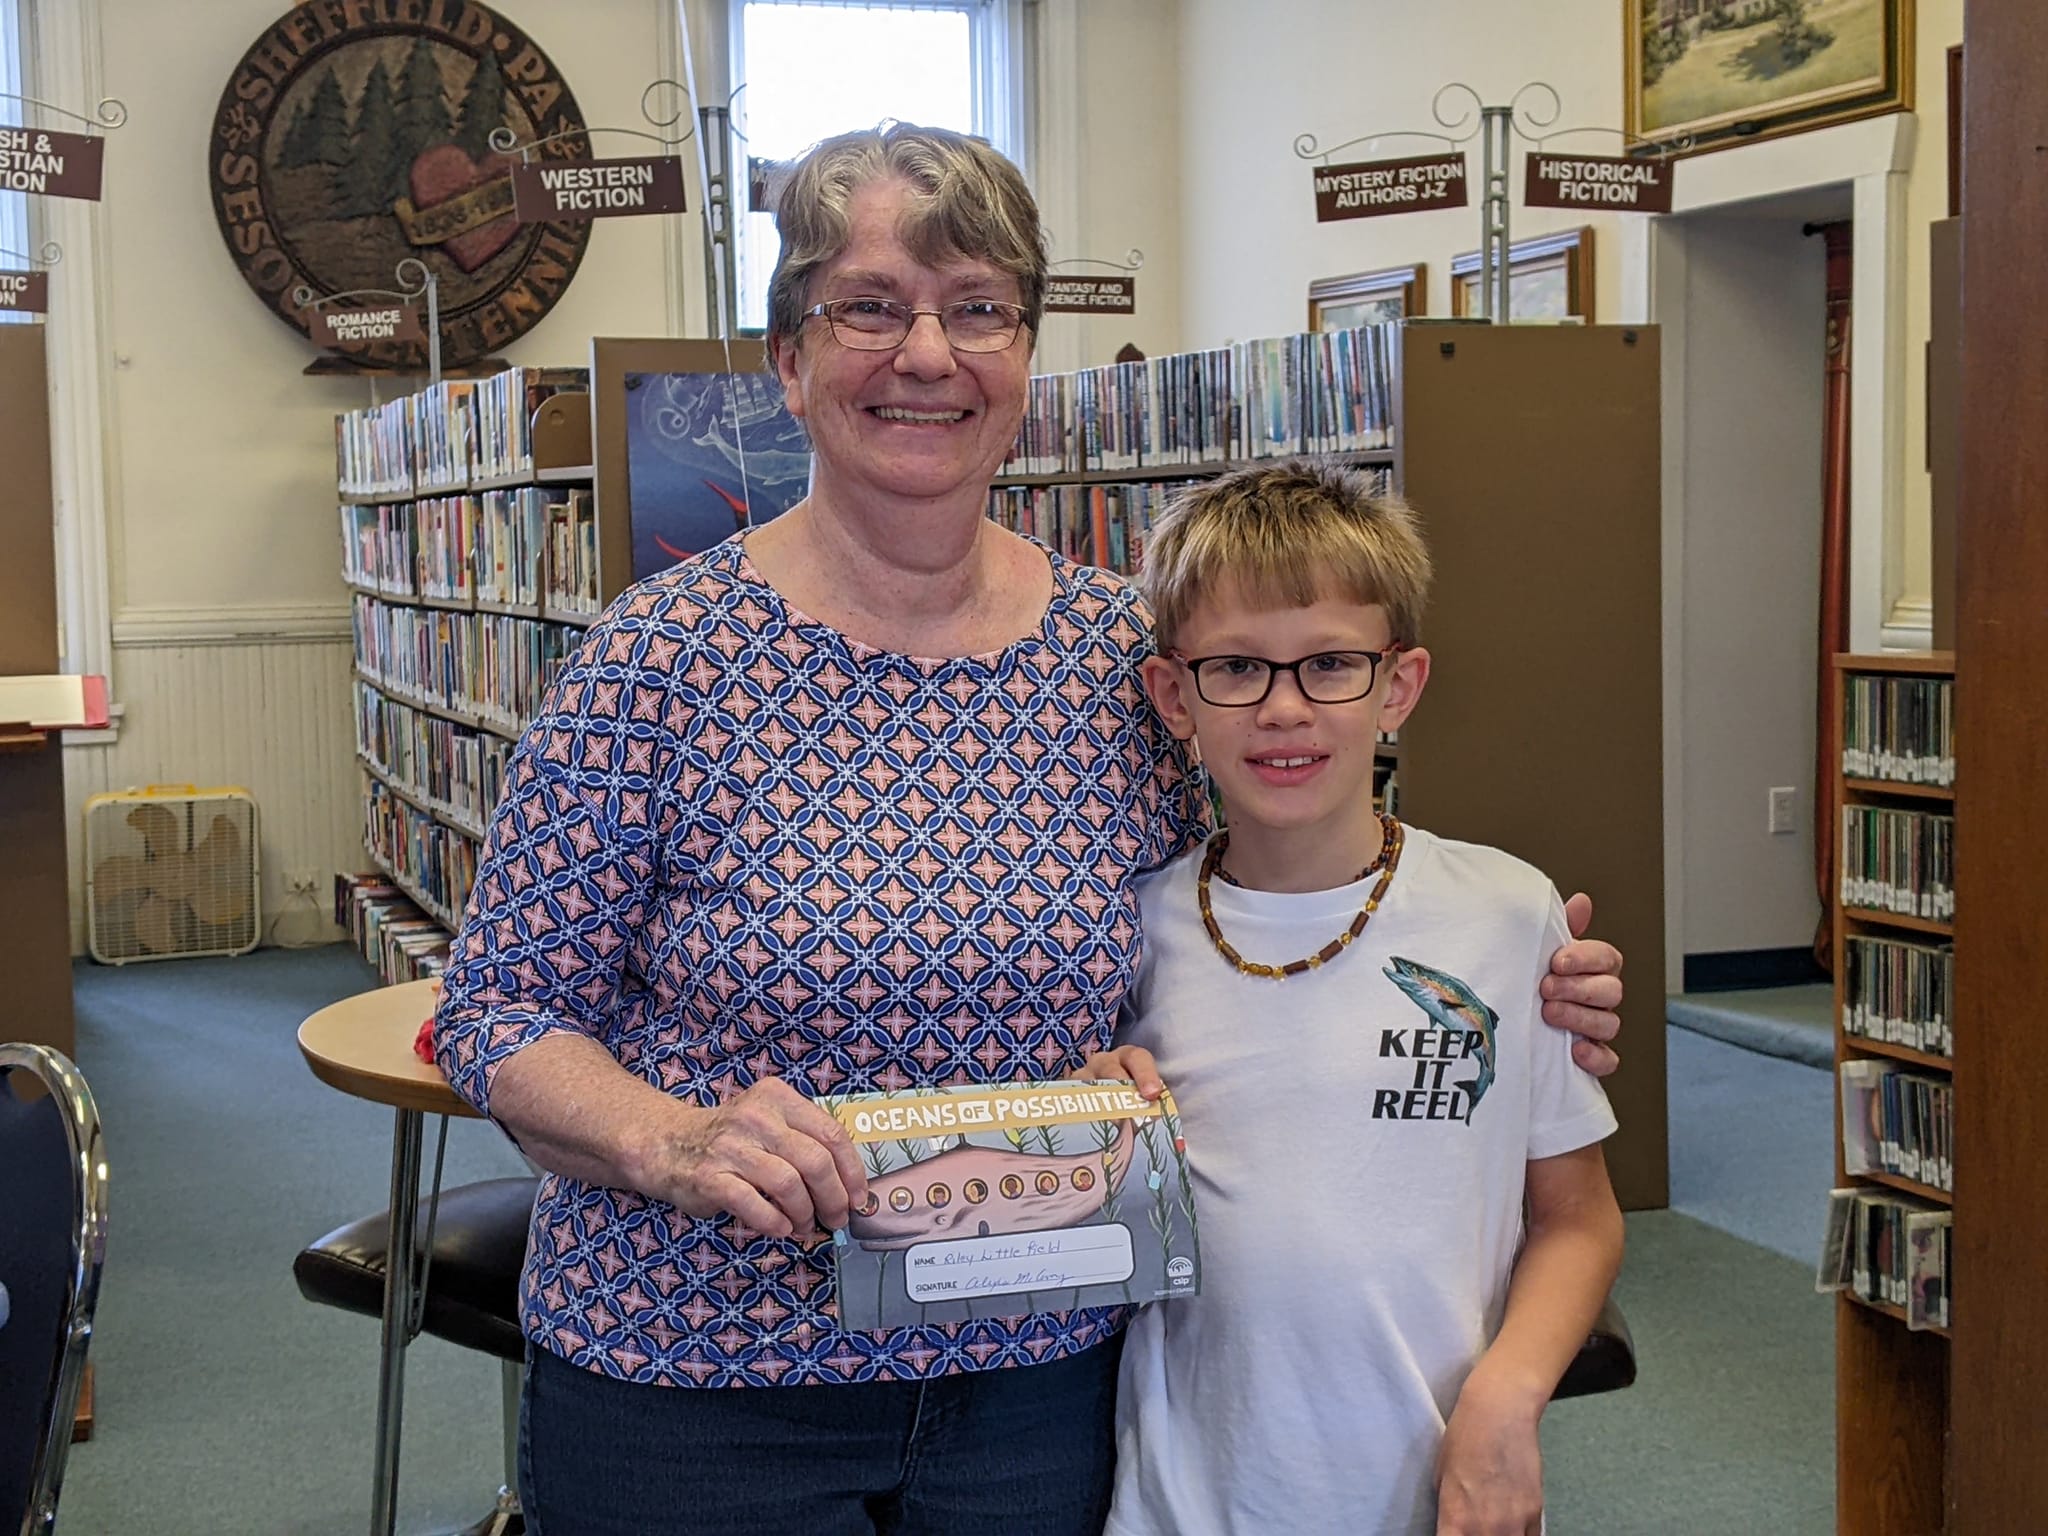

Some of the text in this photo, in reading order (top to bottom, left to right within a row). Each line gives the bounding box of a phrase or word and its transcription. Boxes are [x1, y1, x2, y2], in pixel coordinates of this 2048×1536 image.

[34, 134, 52, 153] &
[540, 165, 653, 190] WESTERN
[1316, 162, 1463, 193] MYSTERY FICTION
[1539, 160, 1659, 185] HISTORICAL
[556, 187, 645, 211] FICTION
[1336, 181, 1447, 208] AUTHORS J-Z
[1559, 181, 1638, 203] FICTION
[1048, 282, 1124, 294] FANTASY AND
[1088, 294, 1132, 306] FICTION
[326, 309, 401, 328] ROMANCE
[337, 324, 394, 340] FICTION
[1379, 1029, 1484, 1059] KEEP
[1413, 1060, 1452, 1089] IT
[855, 1090, 1150, 1133] OCEANS OF POSSIBILITIES
[1372, 1089, 1465, 1120] REEL
[914, 1257, 936, 1265] NAME
[916, 1281, 958, 1293] SIGNATURE
